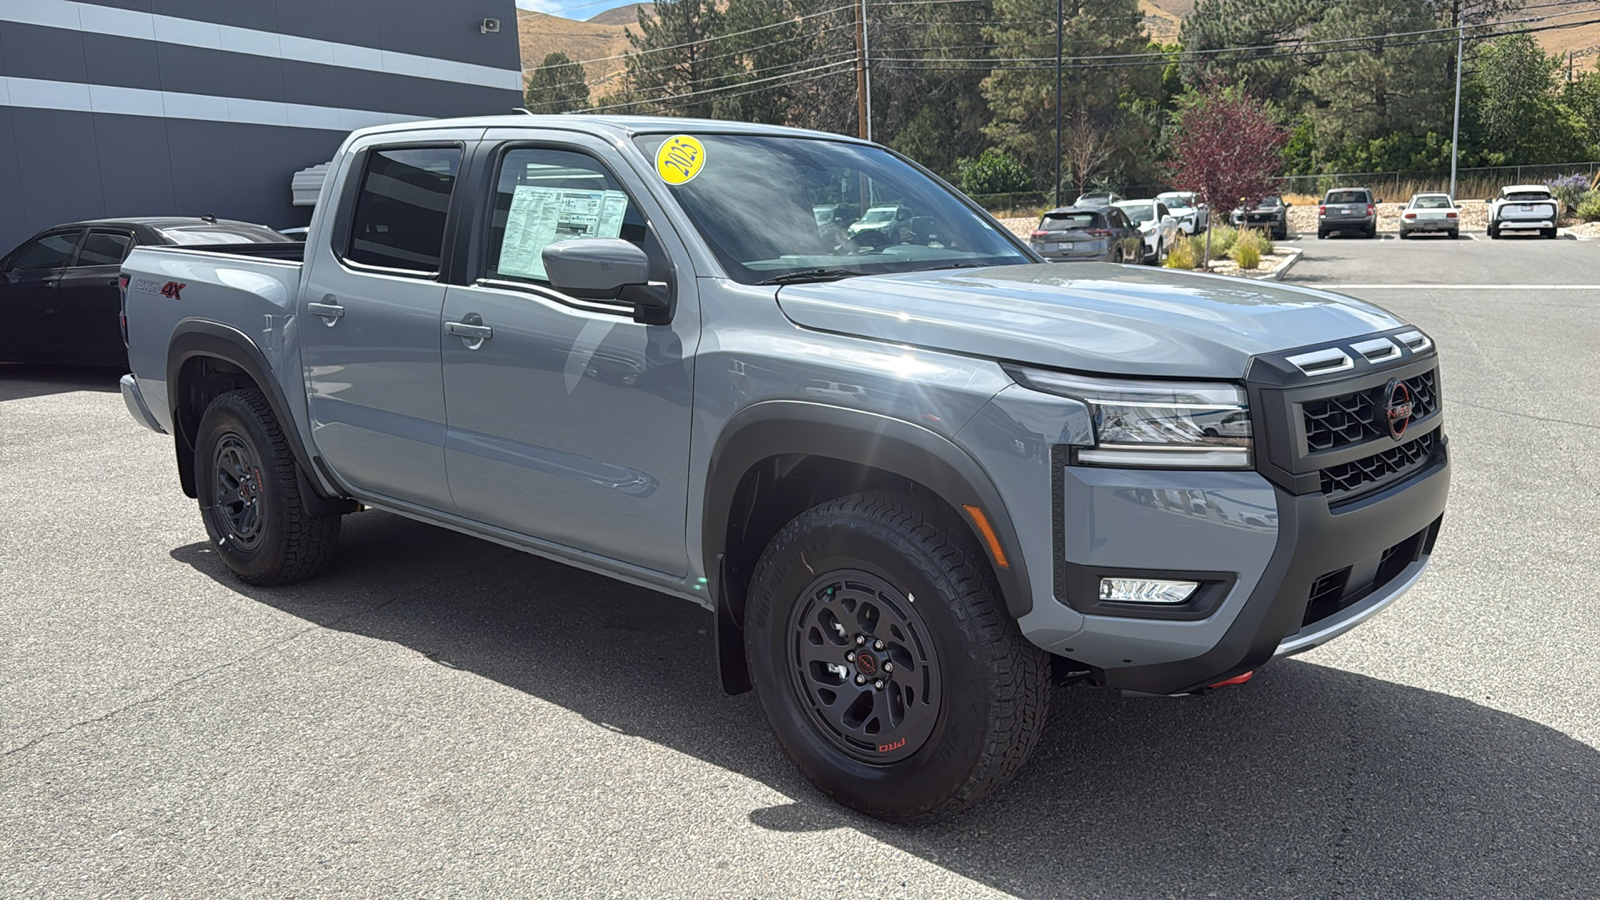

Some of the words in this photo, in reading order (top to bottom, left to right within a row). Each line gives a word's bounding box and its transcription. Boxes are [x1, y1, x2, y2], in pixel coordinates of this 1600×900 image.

[664, 138, 698, 177] 2025
[1387, 405, 1410, 419] NISS
[879, 736, 906, 752] PRO
